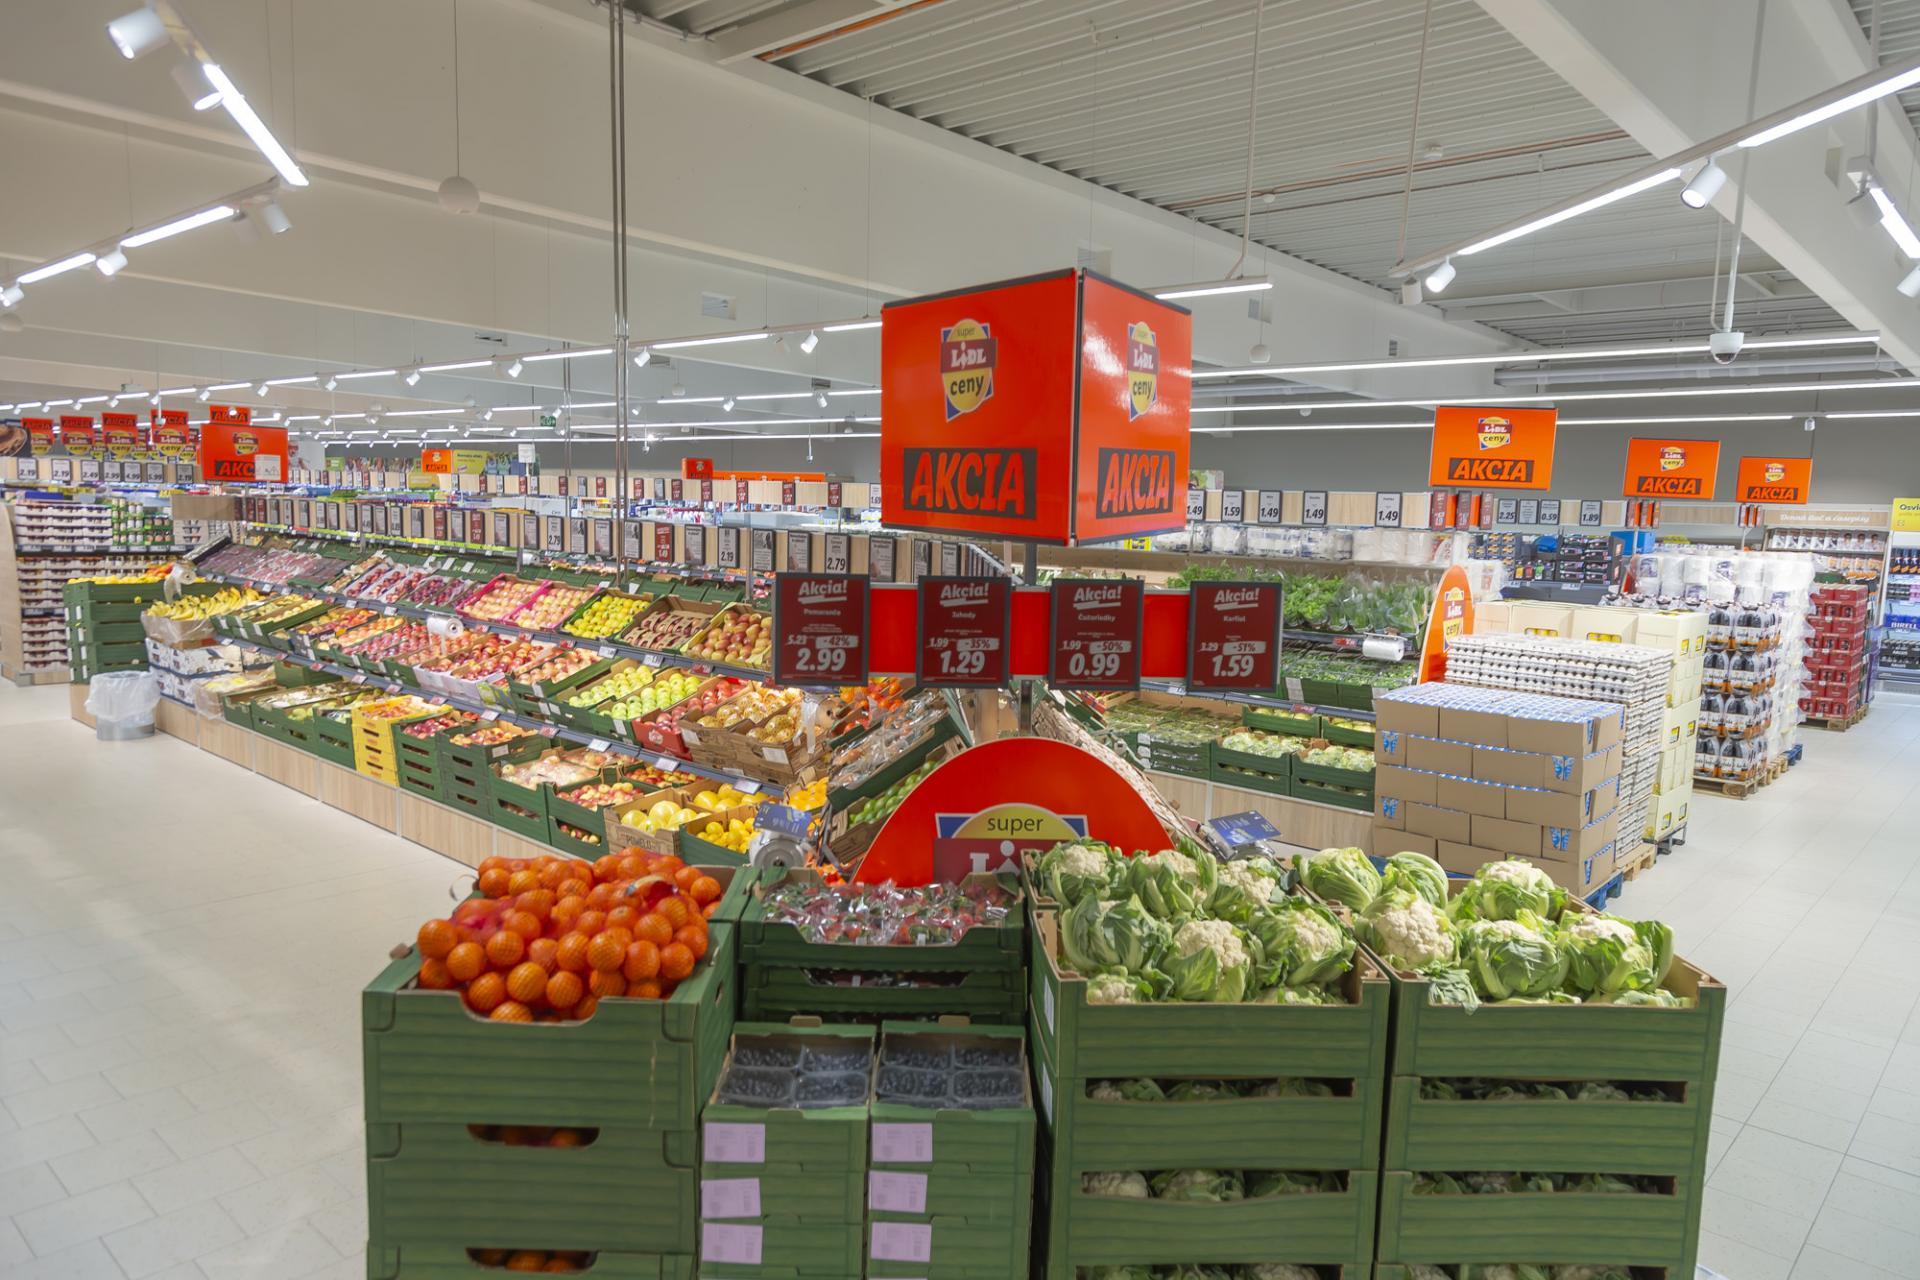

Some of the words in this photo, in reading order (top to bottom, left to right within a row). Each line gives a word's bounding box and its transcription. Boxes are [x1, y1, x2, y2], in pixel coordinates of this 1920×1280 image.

[950, 375, 985, 395] ceny
[1133, 381, 1153, 400] ceny
[1483, 435, 1505, 443] ceny
[220, 460, 255, 476] AKC
[1453, 459, 1527, 482] AKCIA
[911, 452, 1025, 515] AKCIA
[1102, 453, 1170, 514] AKCIA
[1642, 478, 1697, 493] AKCIA
[1750, 488, 1794, 500] AKCIA
[1224, 506, 1240, 516] 1.59
[1260, 507, 1278, 517] 1.49
[1305, 508, 1324, 519] 1.49
[1378, 510, 1398, 521] 1.49
[827, 557, 846, 571] 2.79
[798, 580, 849, 596] Akcia!
[940, 582, 989, 600] Akcia!
[1073, 586, 1122, 602] Akcia!
[1214, 588, 1260, 604] Akcia!
[795, 647, 846, 672] 2.99
[940, 650, 985, 674] 1.29
[1069, 652, 1120, 676] 0.99
[1212, 654, 1254, 677] 1.59
[987, 817, 1044, 835] super
